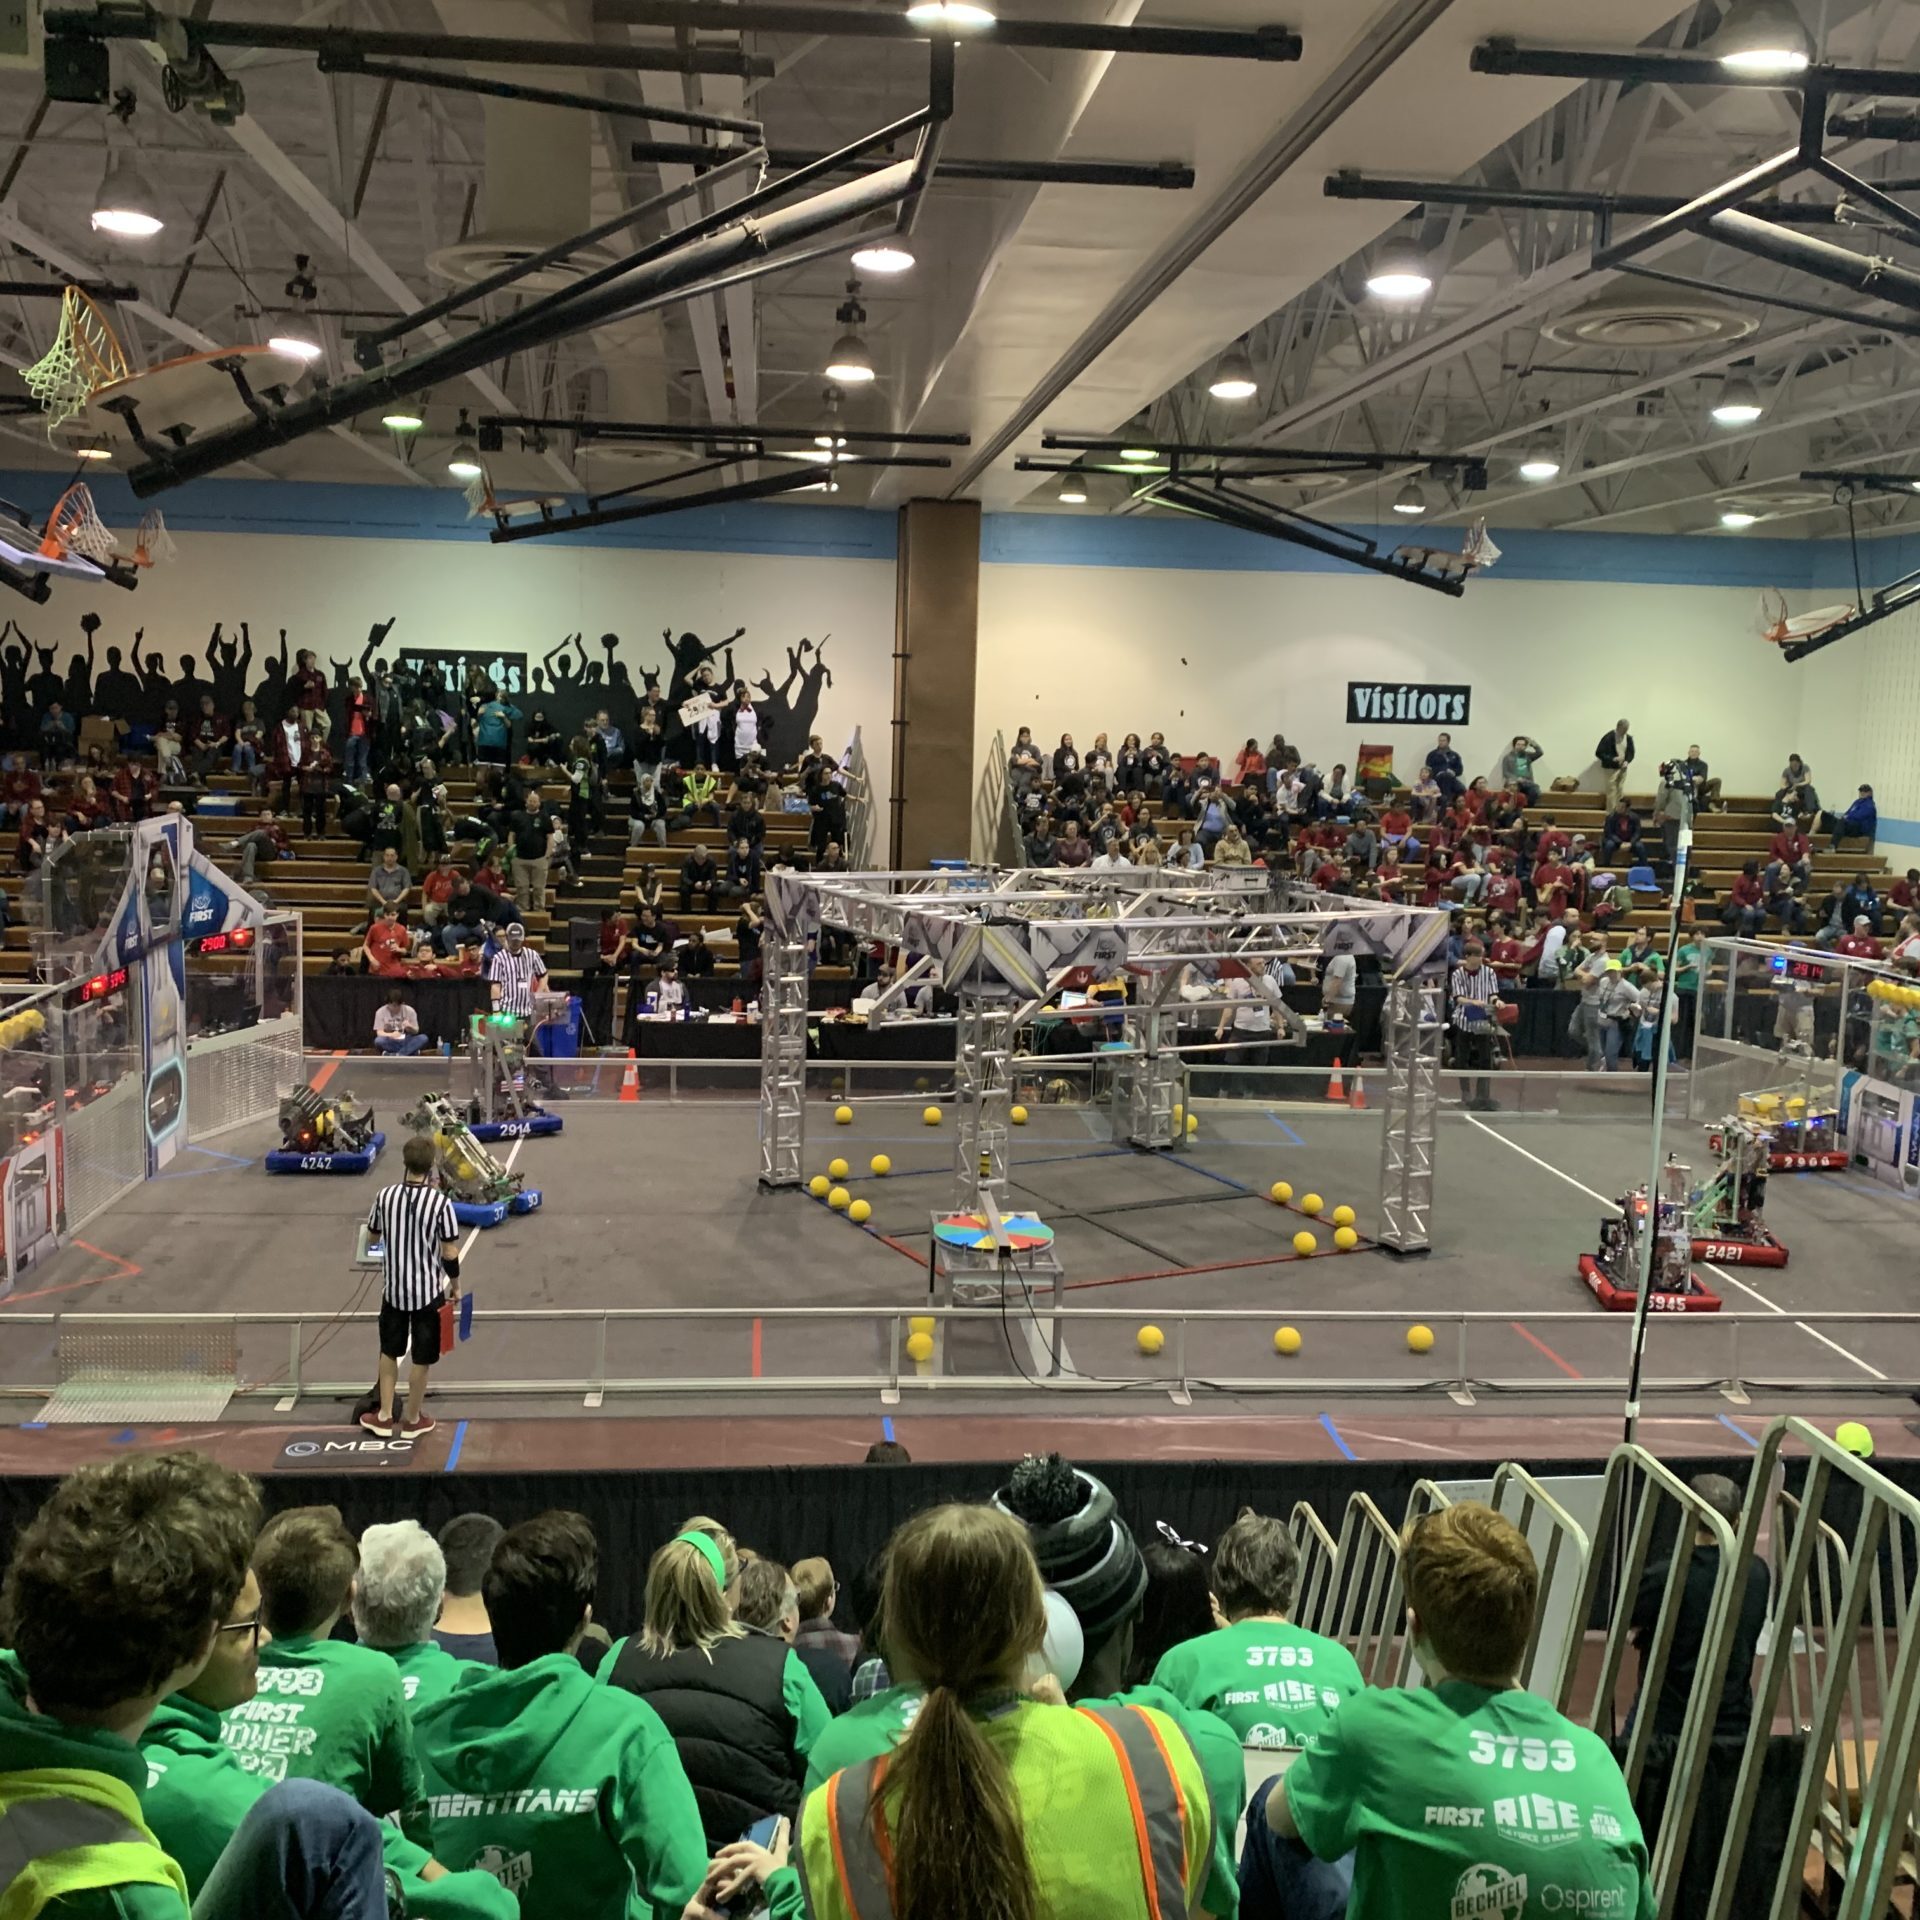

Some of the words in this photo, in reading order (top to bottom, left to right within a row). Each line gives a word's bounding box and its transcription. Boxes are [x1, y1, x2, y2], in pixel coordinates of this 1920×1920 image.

[1353, 685, 1466, 721] Visitors
[189, 908, 214, 922] FIRST
[201, 934, 226, 952] 2900
[1093, 950, 1117, 961] FIRST
[1793, 962, 1824, 978] 2914
[500, 1121, 532, 1137] 2914
[300, 1156, 333, 1170] 4242
[528, 1193, 538, 1208] 93
[494, 1206, 504, 1221] 37
[1705, 1244, 1743, 1261] 2421
[324, 1440, 414, 1452] MBC
[1245, 1645, 1314, 1668] 3793
[255, 1666, 325, 1697] 793
[1224, 1691, 1260, 1706] FIRST
[1263, 1679, 1318, 1702] RISE
[229, 1701, 305, 1725] FIRST
[1468, 1729, 1577, 1773] 3793
[1424, 1805, 1485, 1828] FIRST
[1492, 1792, 1583, 1830] RISE
[1455, 1880, 1524, 1918] BECHTEL
